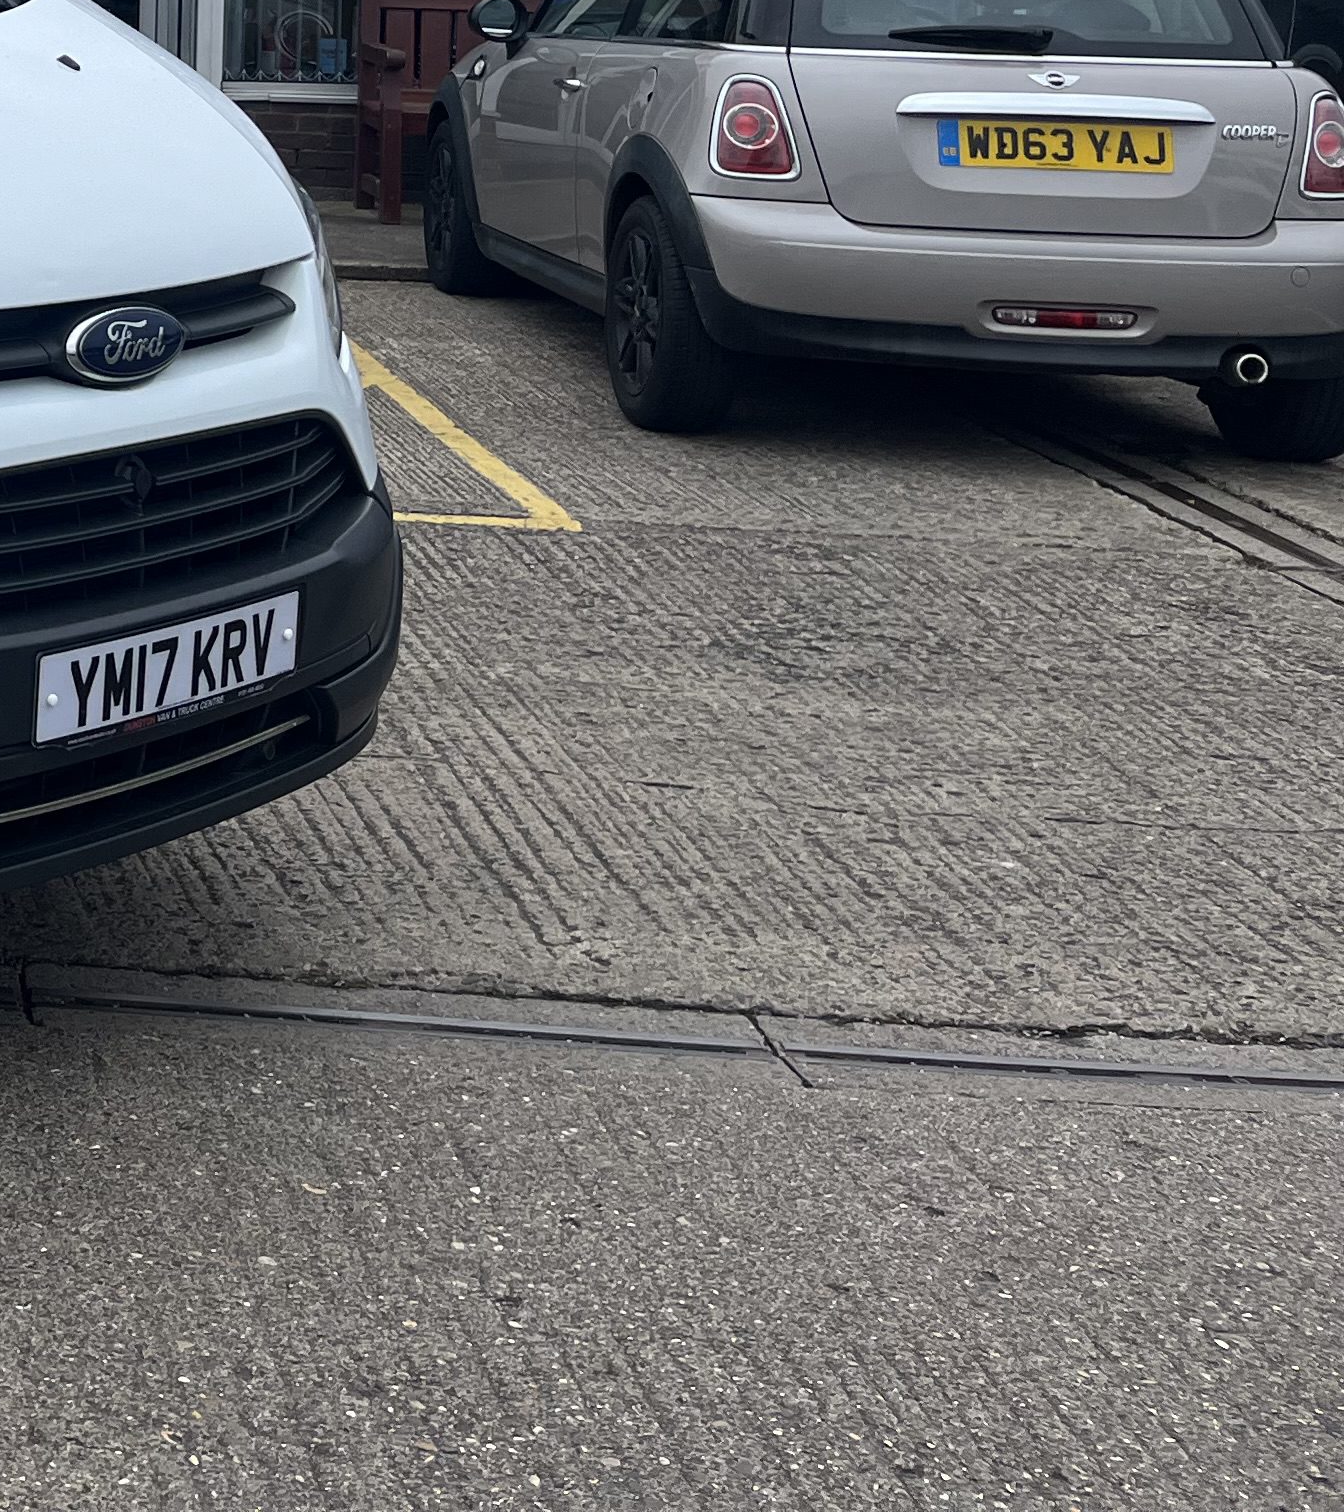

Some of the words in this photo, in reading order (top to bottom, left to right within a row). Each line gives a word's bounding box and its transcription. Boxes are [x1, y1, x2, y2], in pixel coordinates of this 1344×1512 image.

[967, 125, 1075, 161] WD63
[1087, 129, 1166, 165] YAJ
[1222, 124, 1277, 139] COOPER
[104, 319, 166, 365] Ford
[70, 636, 180, 728] YM17
[190, 608, 276, 698] KRV
